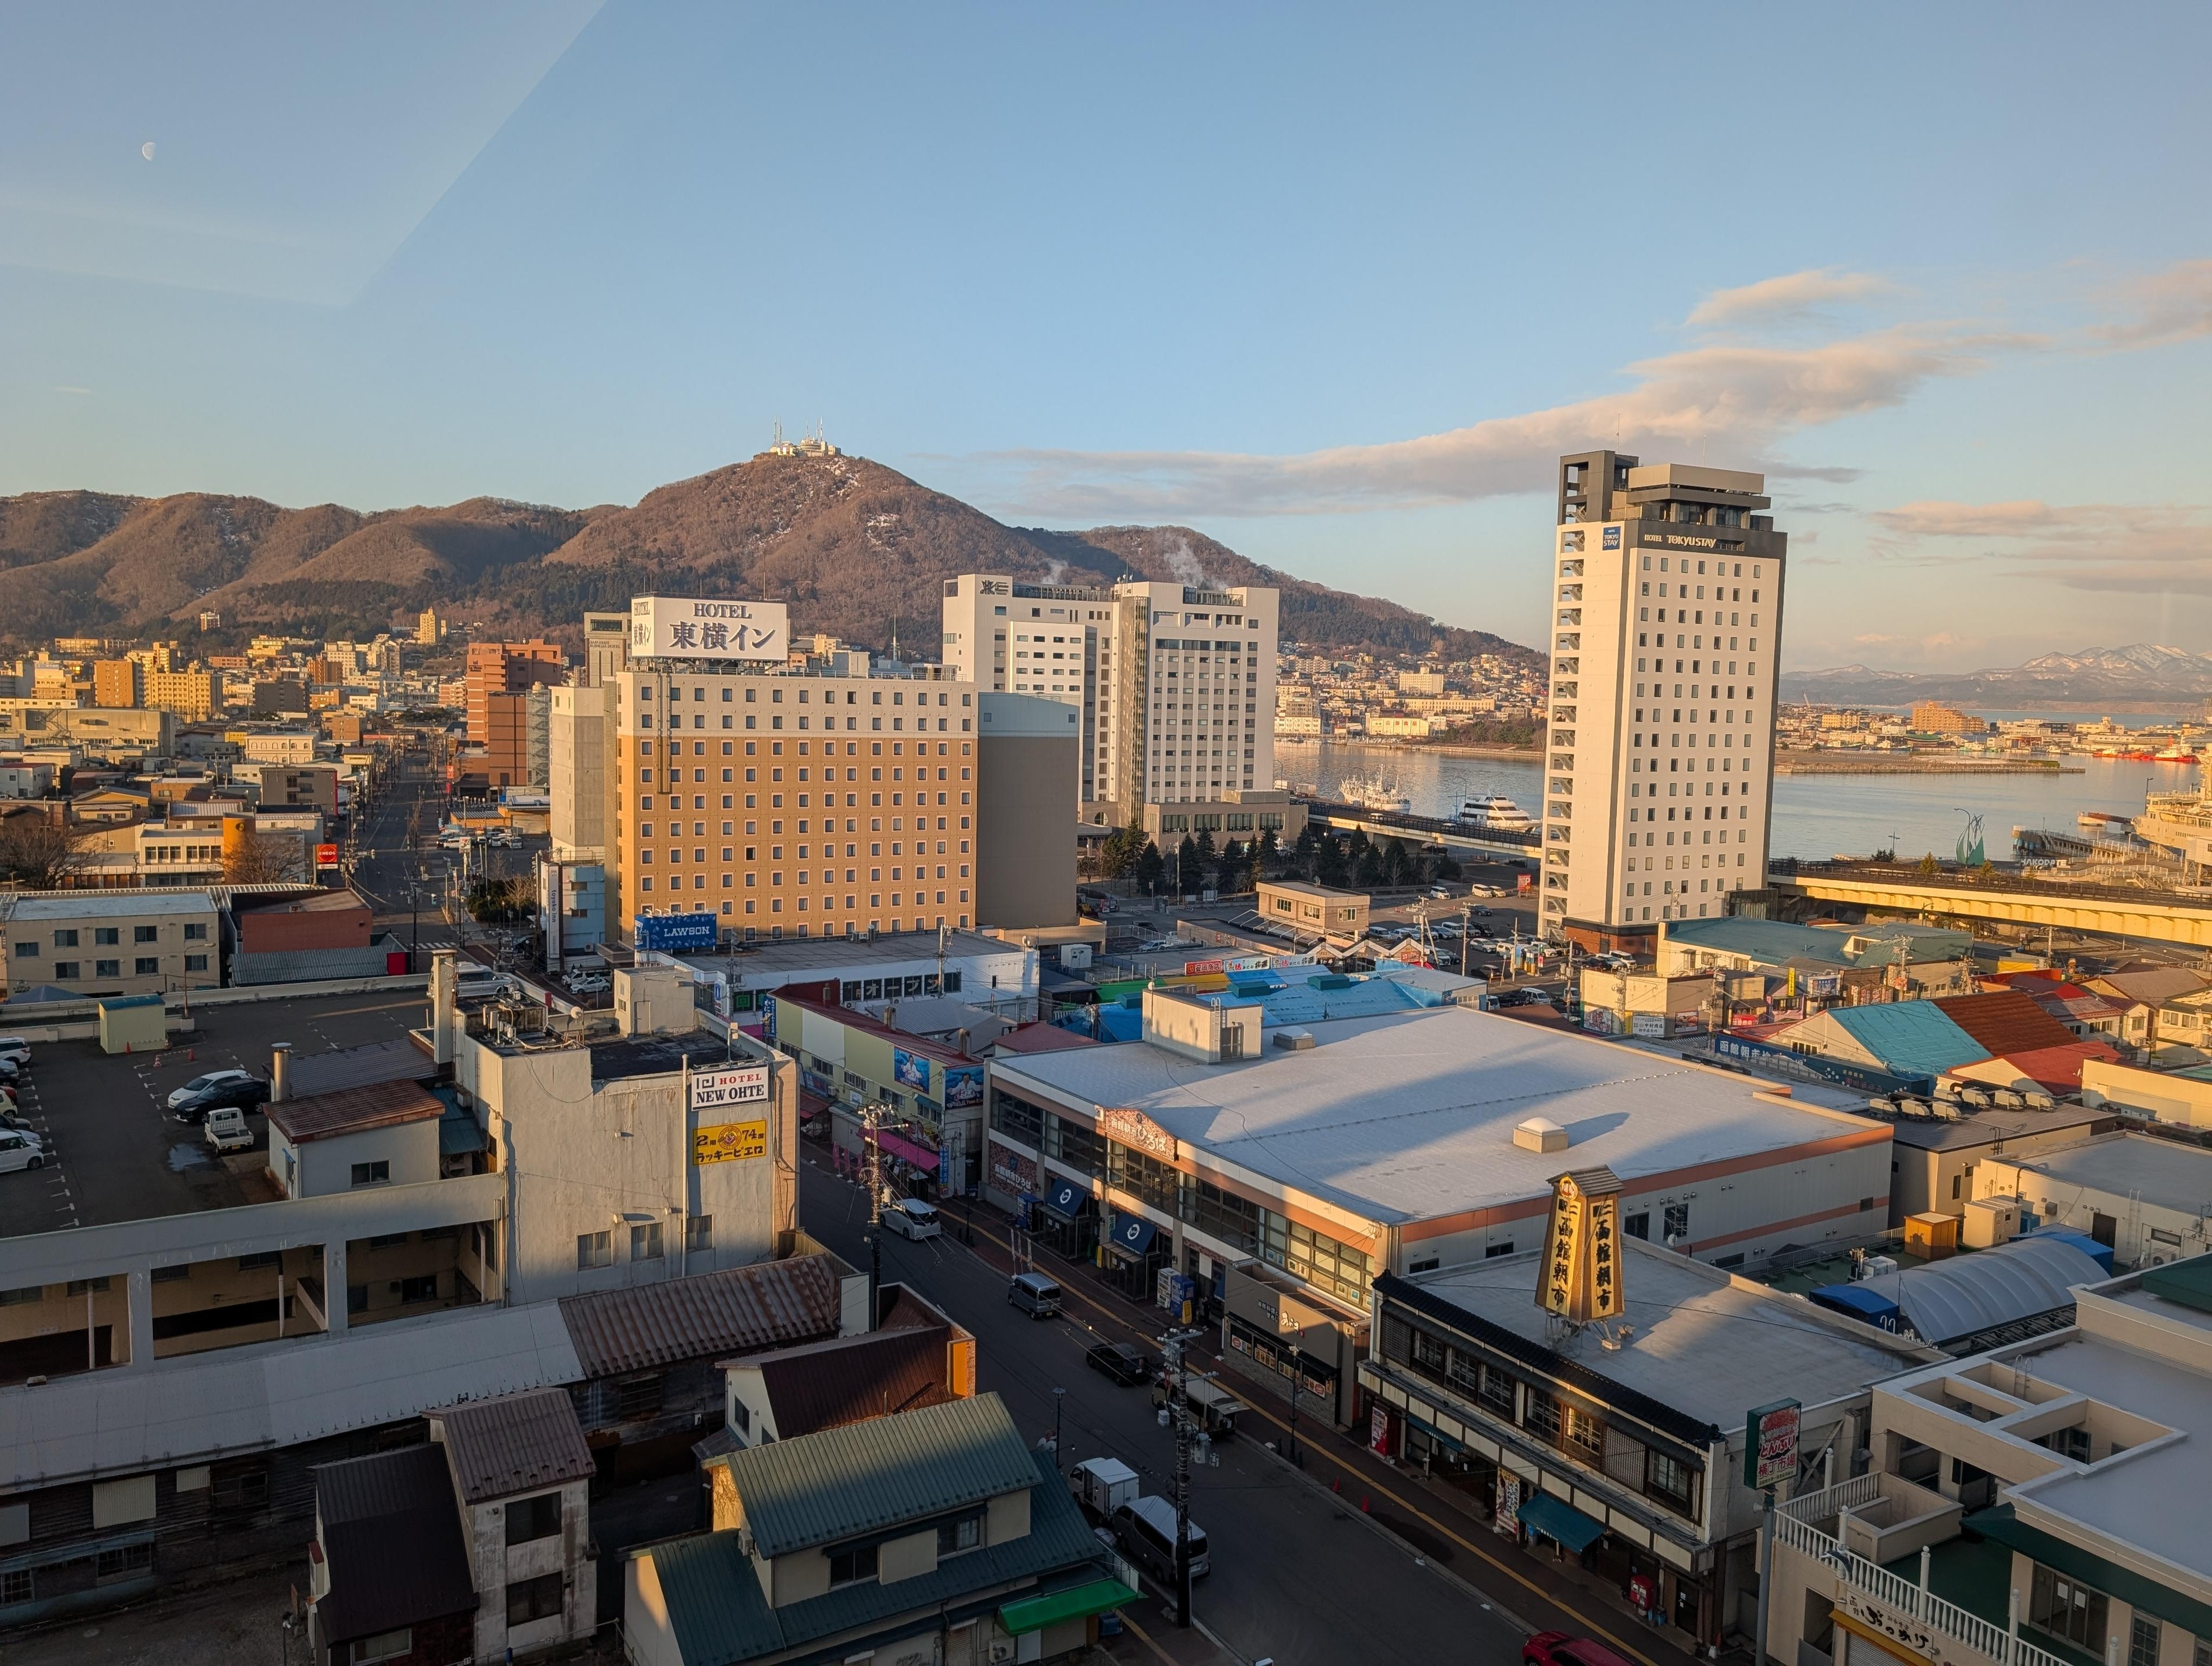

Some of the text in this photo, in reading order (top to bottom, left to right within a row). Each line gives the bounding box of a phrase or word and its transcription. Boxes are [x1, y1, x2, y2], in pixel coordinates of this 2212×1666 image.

[1644, 534, 1663, 542] HOTEL
[634, 601, 650, 616] HOTEL
[693, 603, 752, 619] HOTEL
[633, 623, 651, 646] 東横イン
[668, 621, 776, 651] 東横イン
[1525, 877, 1531, 886] P
[664, 926, 710, 937] LAWSON
[1194, 962, 1220, 972] 安岡商店
[866, 978, 939, 996] オープン
[719, 1074, 762, 1085] HOTEL
[696, 1084, 764, 1104] NEW OHTE
[1111, 1117, 1166, 1152] 函館朝市ひろば
[696, 1145, 763, 1162] ラッキーピエロ
[995, 1163, 1031, 1189] 函館朝市ひろば
[1551, 1216, 1574, 1306] 函館朝市
[1596, 1219, 1612, 1311] 函館朝市
[1760, 1434, 1796, 1458] どんぶり
[1758, 1452, 1796, 1476] 横丁市場
